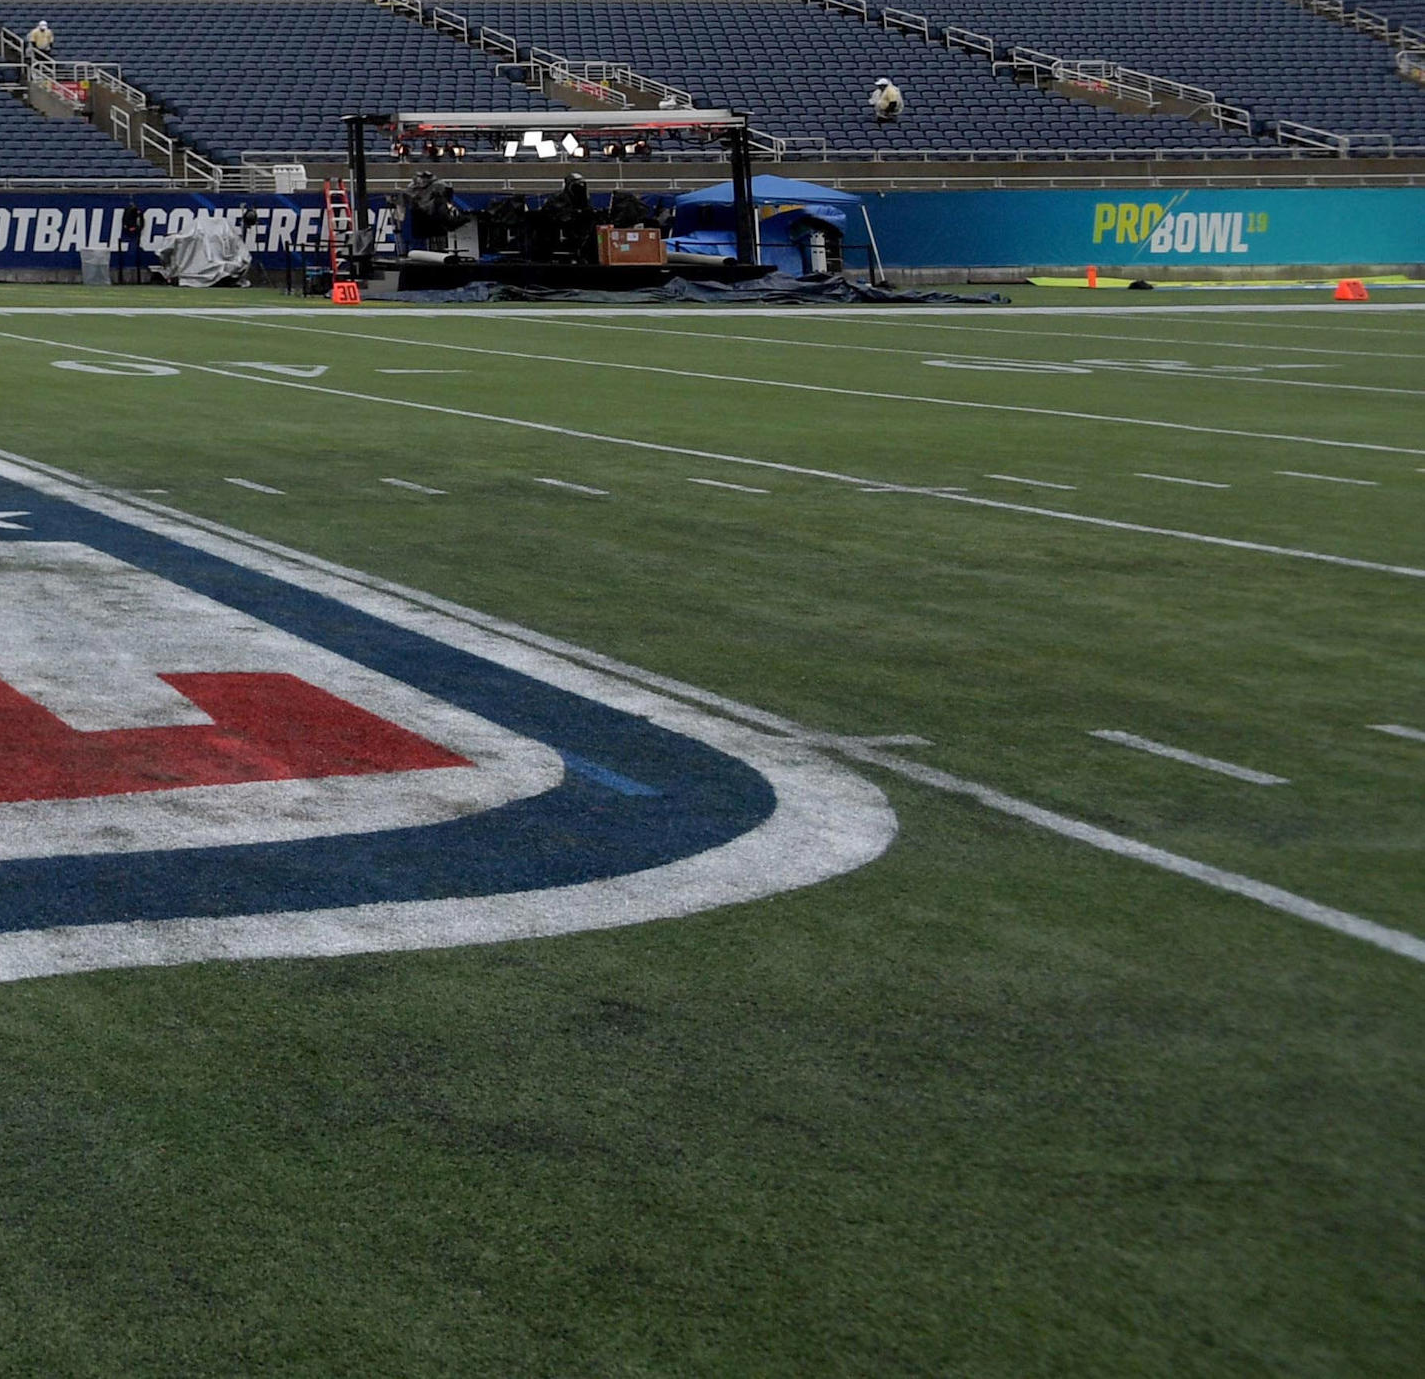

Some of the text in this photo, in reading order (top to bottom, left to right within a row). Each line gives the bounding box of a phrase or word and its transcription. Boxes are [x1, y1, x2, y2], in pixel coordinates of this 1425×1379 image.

[1092, 203, 1165, 244] PRO
[1150, 210, 1249, 254] BOWL
[1247, 211, 1269, 234] 19
[337, 284, 357, 302] 30
